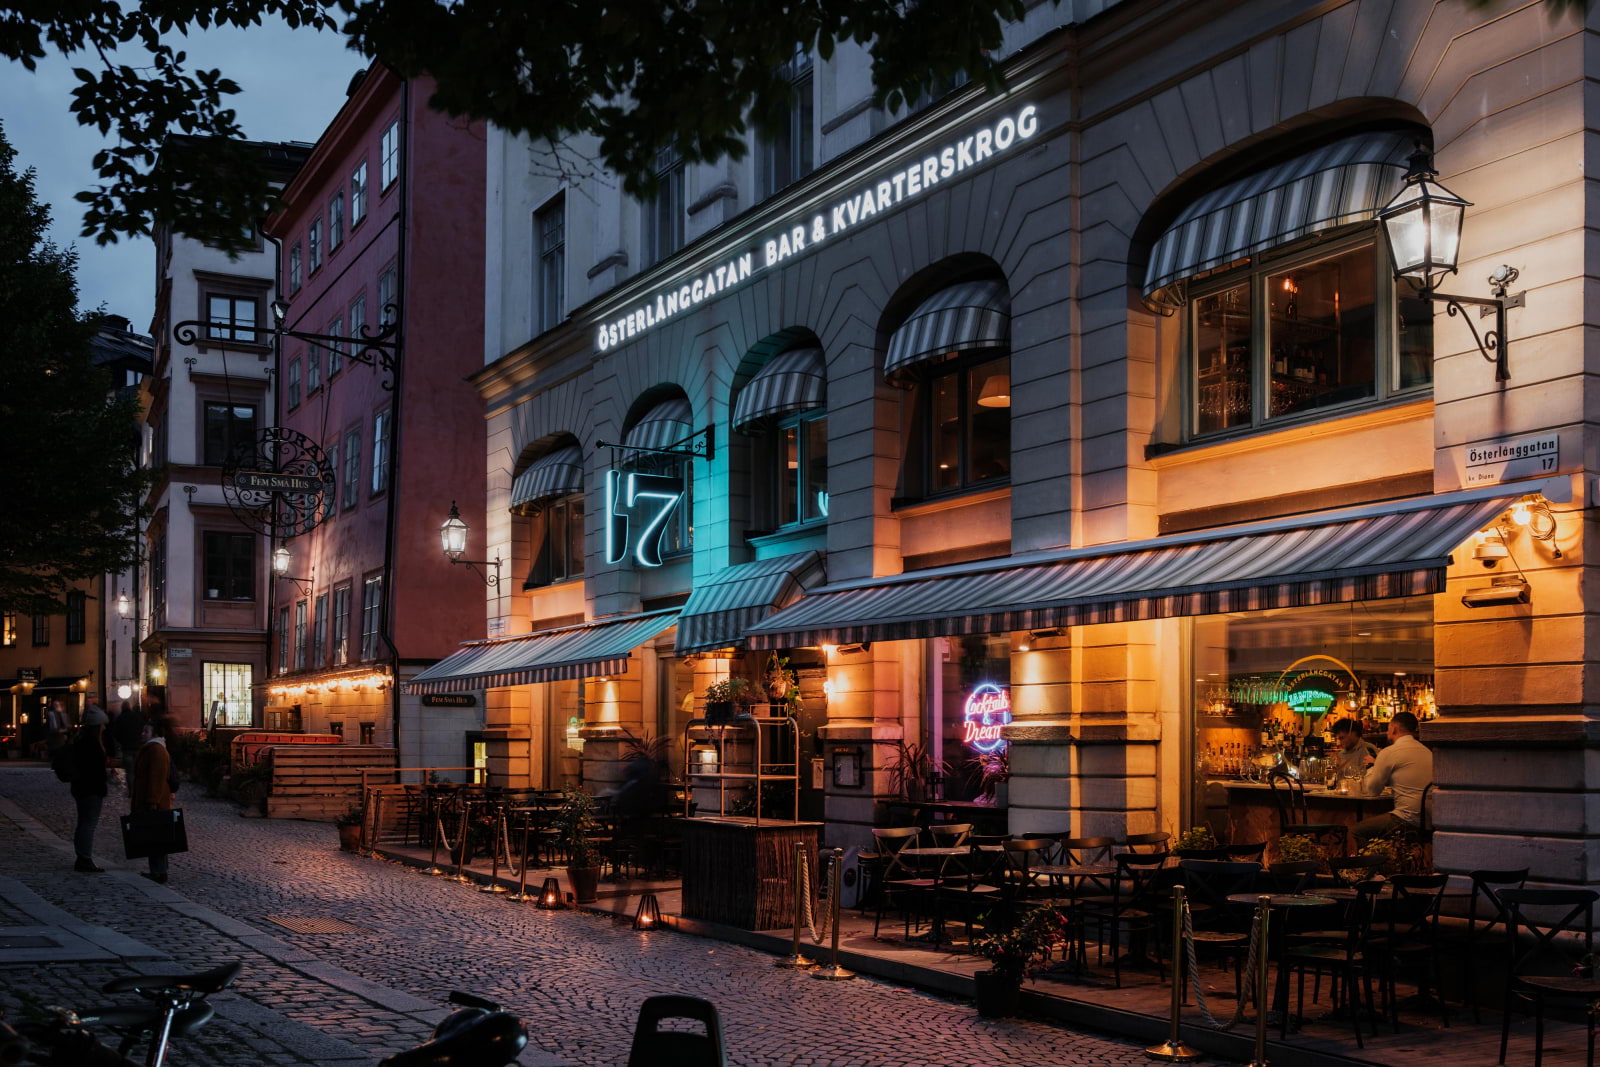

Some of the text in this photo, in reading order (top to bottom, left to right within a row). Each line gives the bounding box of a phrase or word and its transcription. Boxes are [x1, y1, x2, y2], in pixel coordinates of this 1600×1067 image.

[598, 105, 1038, 351] ÖSTERLÅNGGATAN BAR & KVARTERSKROG
[1470, 440, 1555, 462] Österlånggatan
[1541, 458, 1555, 471] 17
[606, 469, 685, 567] 17
[964, 720, 1003, 743] Dream
